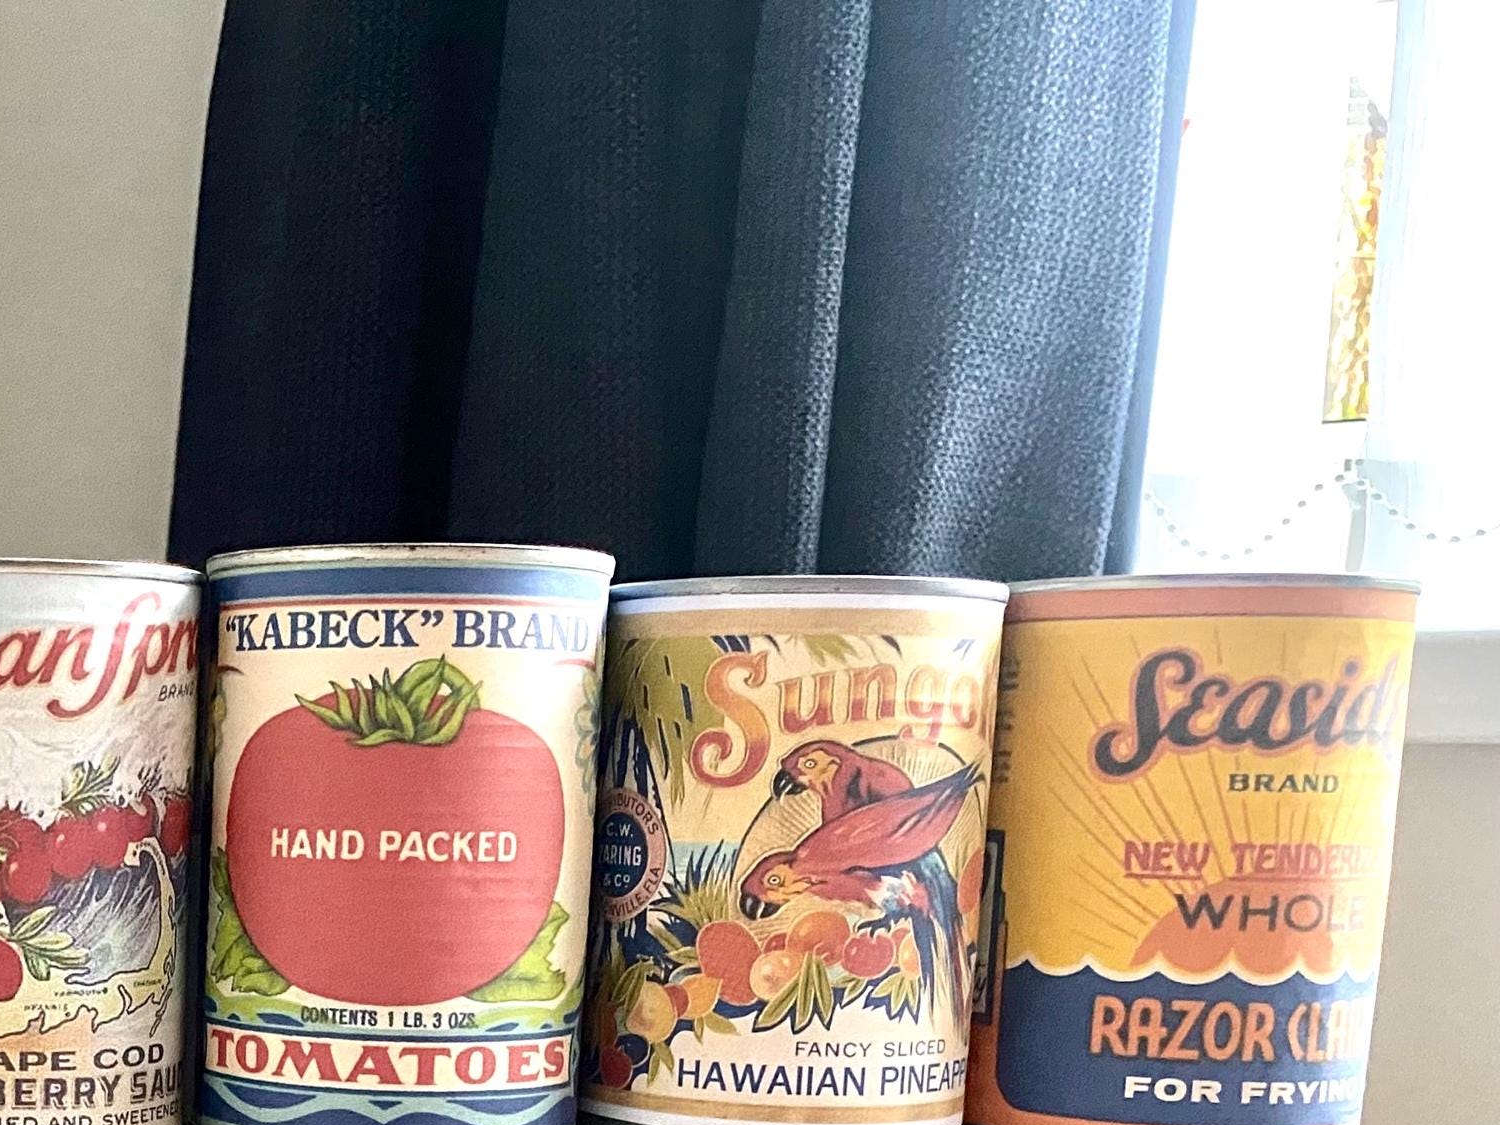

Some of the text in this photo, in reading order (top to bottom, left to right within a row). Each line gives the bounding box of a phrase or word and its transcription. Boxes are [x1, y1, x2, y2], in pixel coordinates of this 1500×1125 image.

[452, 608, 589, 653] BRAND
[156, 680, 197, 702] BRAND
[1228, 773, 1339, 793] BRAND
[270, 827, 518, 863] HAND PACKED
[600, 844, 642, 866] ARING
[1124, 840, 1210, 872] NEW
[1174, 892, 1364, 932] WHOLE
[300, 1006, 479, 1030] CONTENTS 1 LB. 3 OZS.
[1090, 995, 1275, 1062] RAZOR
[93, 1043, 165, 1070] COD
[210, 1029, 566, 1087] TOMATOES
[795, 1038, 946, 1058] FANCY SLICED
[677, 1058, 866, 1097] HAWAIIAN
[1123, 1076, 1222, 1104] FOR
